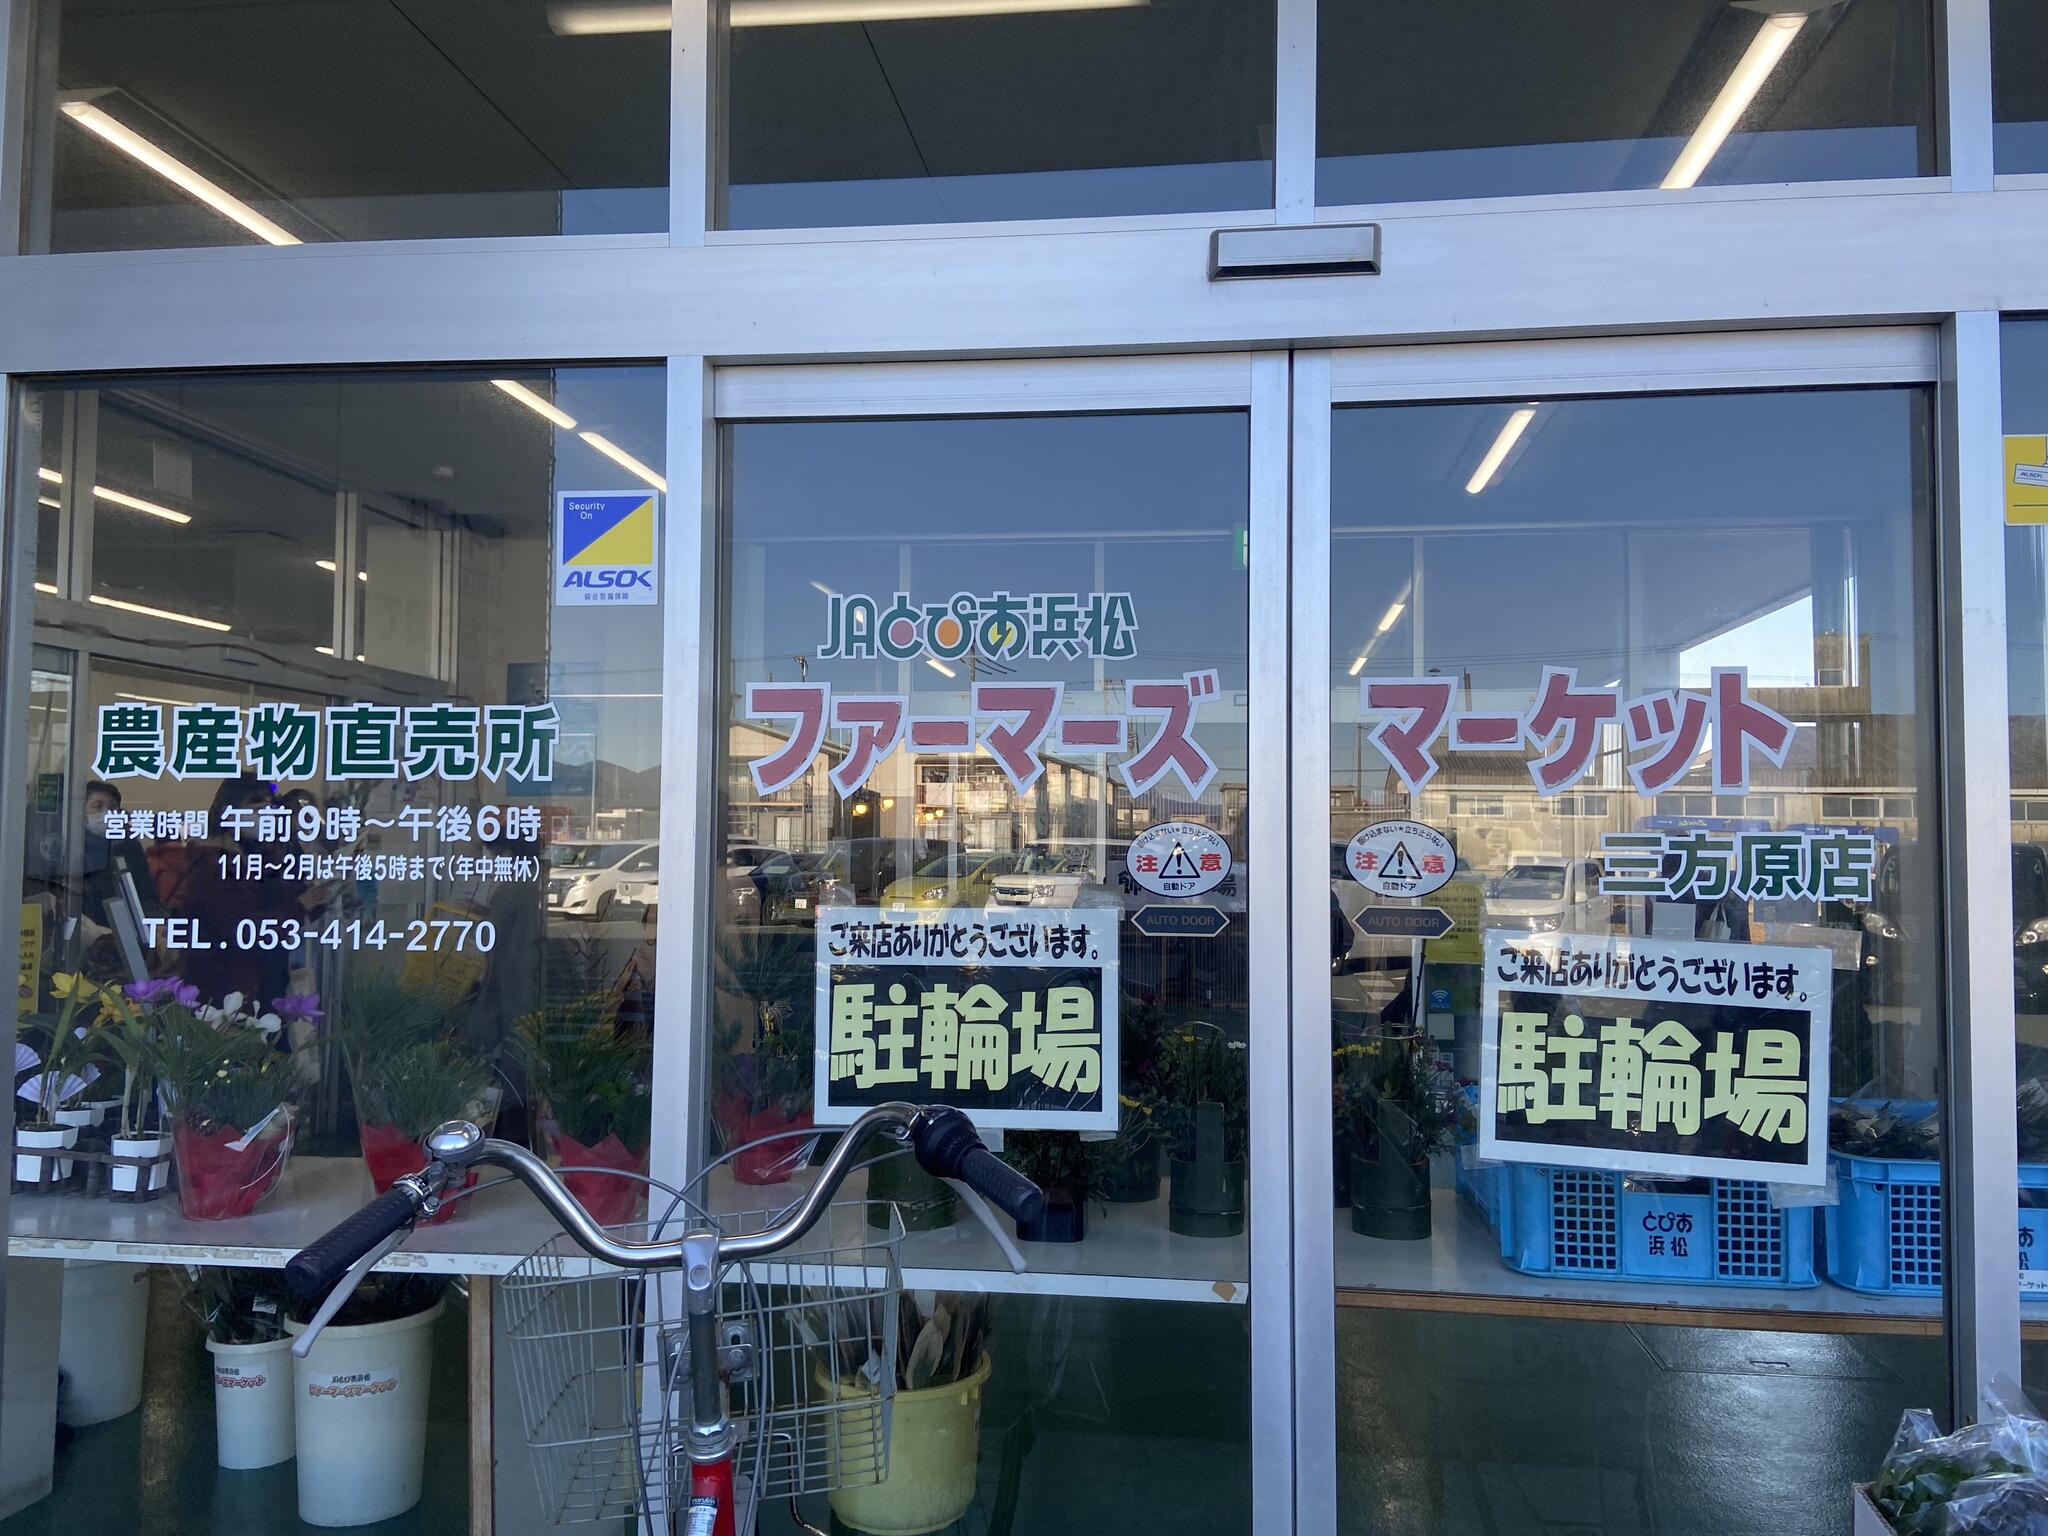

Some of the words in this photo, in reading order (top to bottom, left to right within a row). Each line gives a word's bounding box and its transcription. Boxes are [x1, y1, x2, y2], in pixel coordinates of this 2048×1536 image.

[568, 501, 606, 511] Security
[580, 511, 593, 520] On
[563, 569, 653, 589] ALSOK
[817, 591, 1139, 662] JAとぴあ浜松
[92, 702, 562, 783] 農産物直売所
[746, 668, 1222, 801] ファーマーズ
[1361, 665, 1796, 796] マーケット
[103, 808, 210, 841] 営業時間
[1599, 831, 1874, 903] 三方原店
[1163, 882, 1196, 891] 自動ドア
[1382, 881, 1417, 891] 自動ドア
[236, 917, 497, 953] 053-414-2770
[1146, 914, 1178, 926] AUTO
[1182, 915, 1216, 926] DOOR
[1367, 915, 1402, 927] AUTO
[1404, 916, 1440, 928] DOOR
[828, 922, 1099, 961] ご来店ありがとうございます。
[1497, 947, 1808, 1003] ご来店ありがとうございます。
[830, 981, 1101, 1094] 駐輪場
[1497, 1010, 1808, 1145] 駐輪場
[1642, 1210, 1693, 1234] とぴあ
[1648, 1235, 1688, 1257] 浜松
